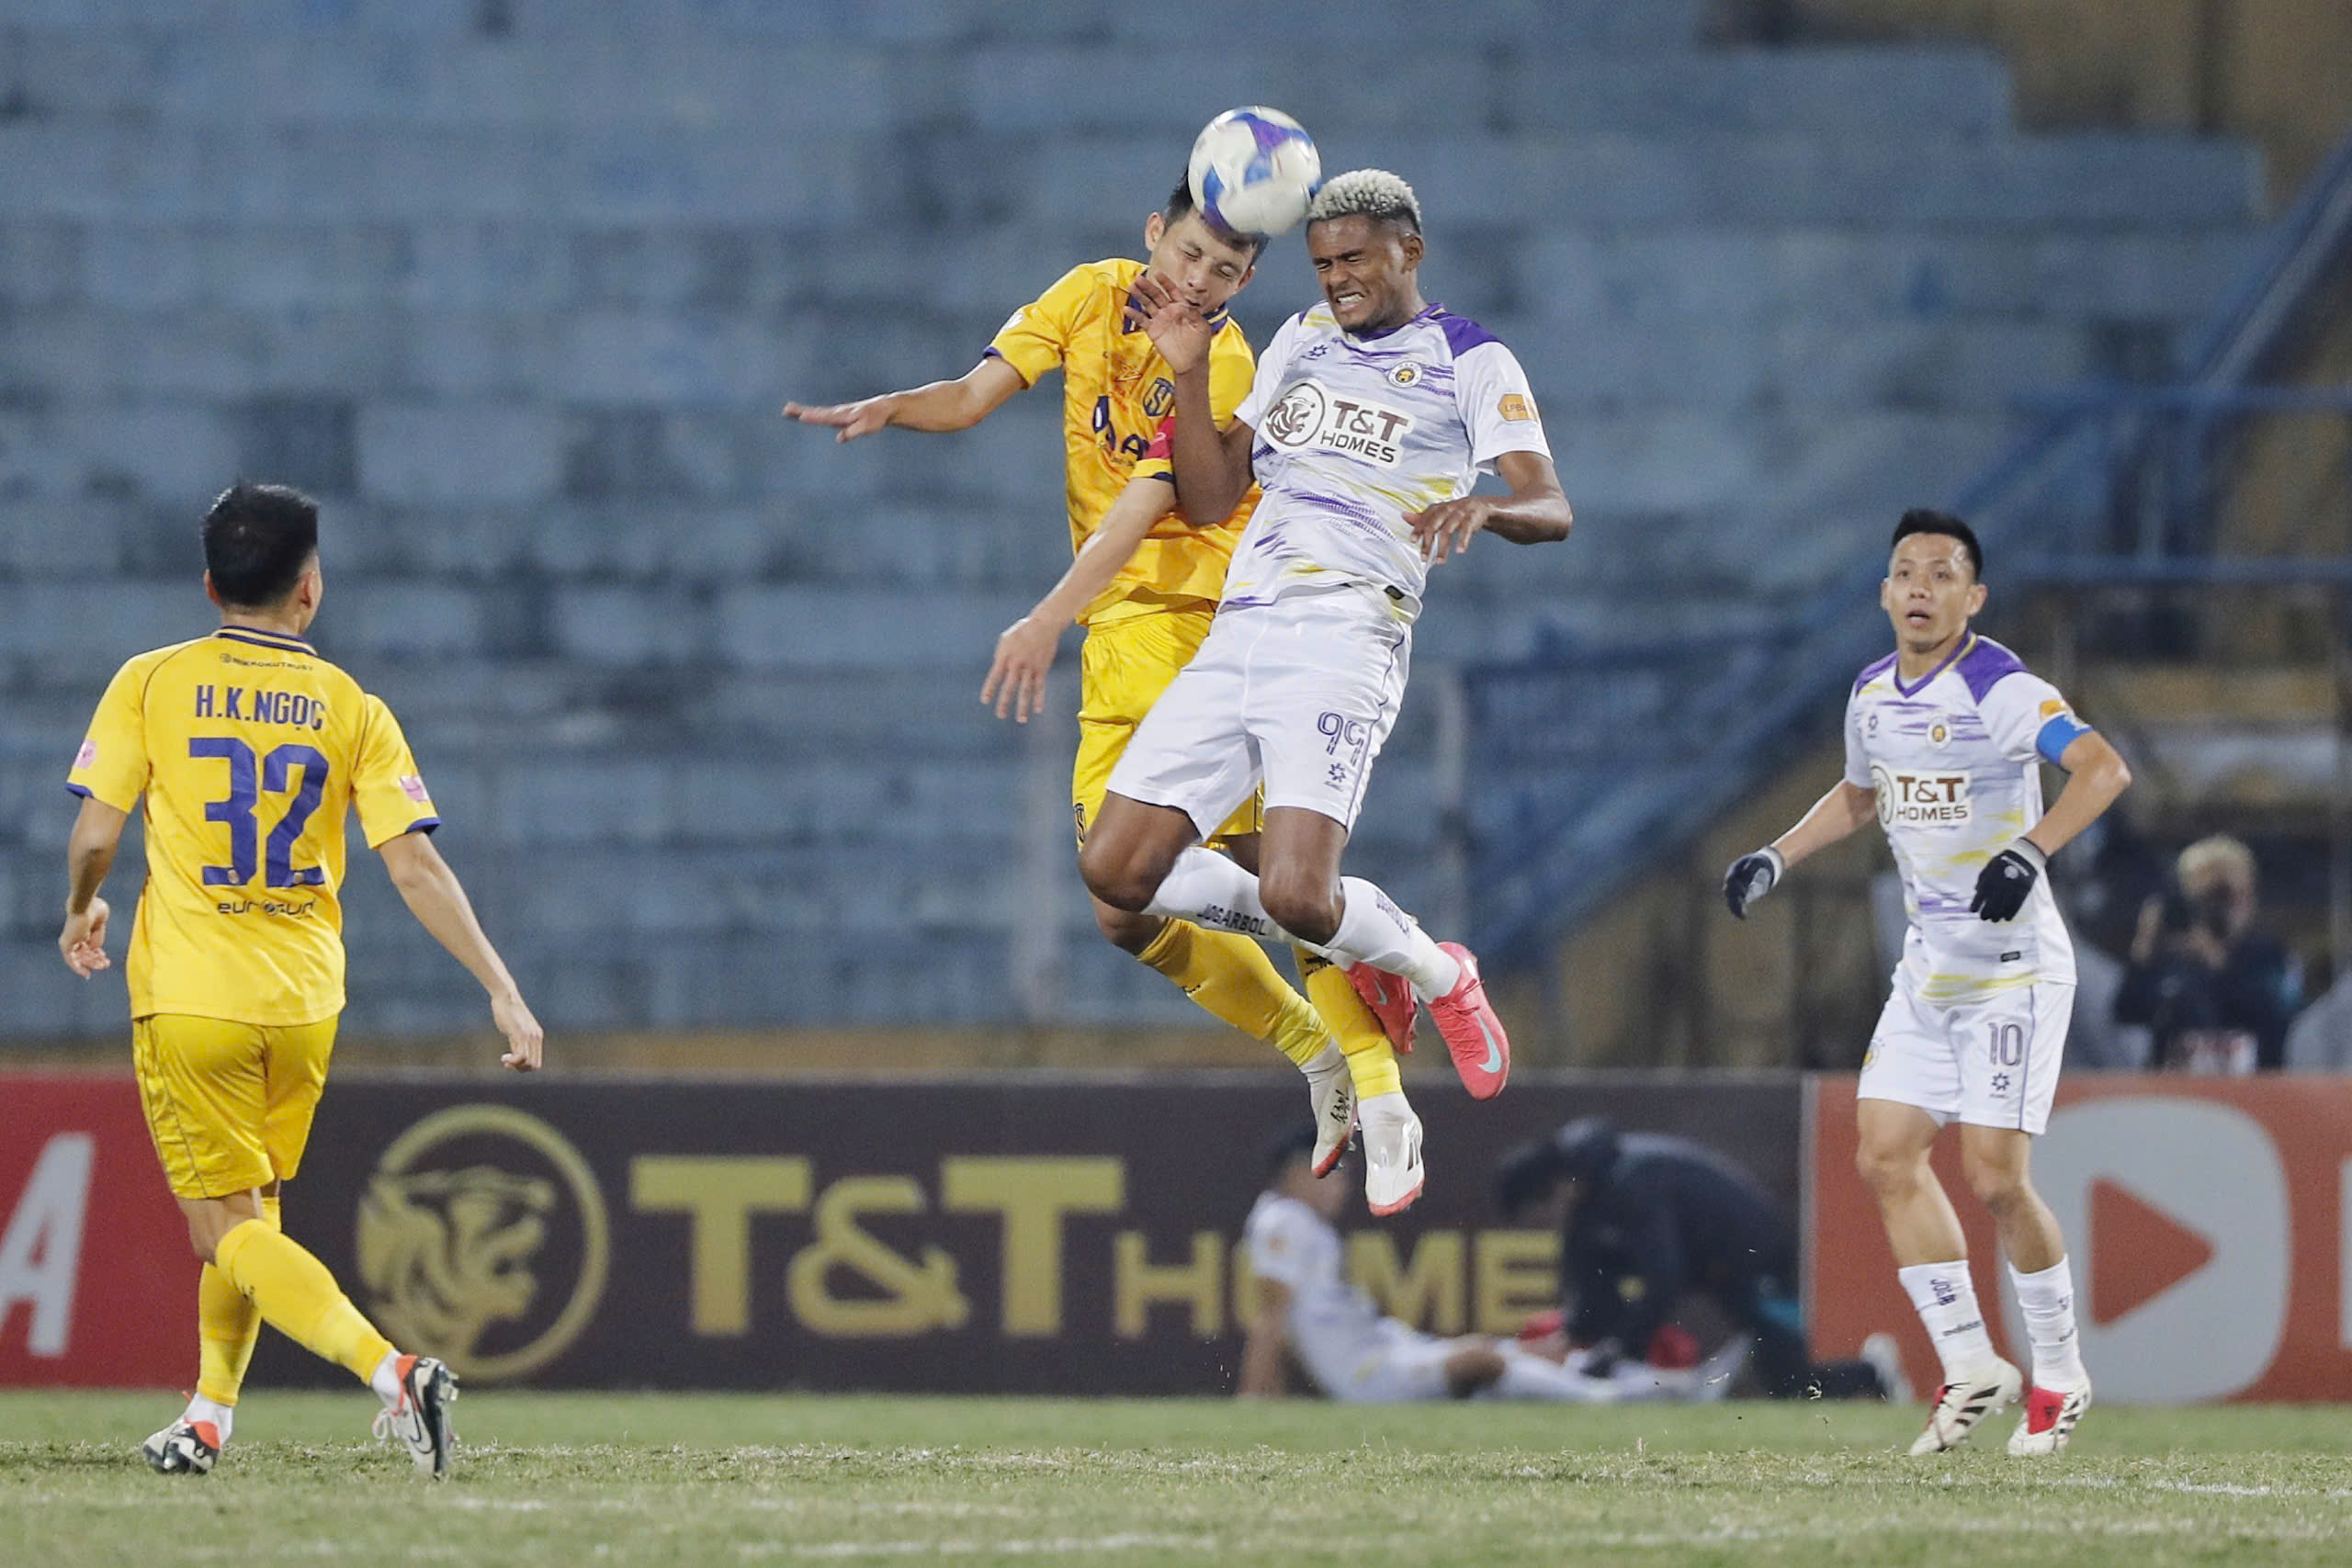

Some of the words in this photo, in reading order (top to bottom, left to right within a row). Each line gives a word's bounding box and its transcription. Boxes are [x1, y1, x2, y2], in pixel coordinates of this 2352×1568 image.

[1333, 400, 1409, 442] T&T
[1319, 430, 1396, 463] HOMES
[1896, 776, 1964, 803] T&T
[188, 738, 330, 888] 32
[1896, 806, 1968, 820] HOMES
[1987, 1021, 2023, 1066] 10
[630, 1155, 1125, 1337] T&T
